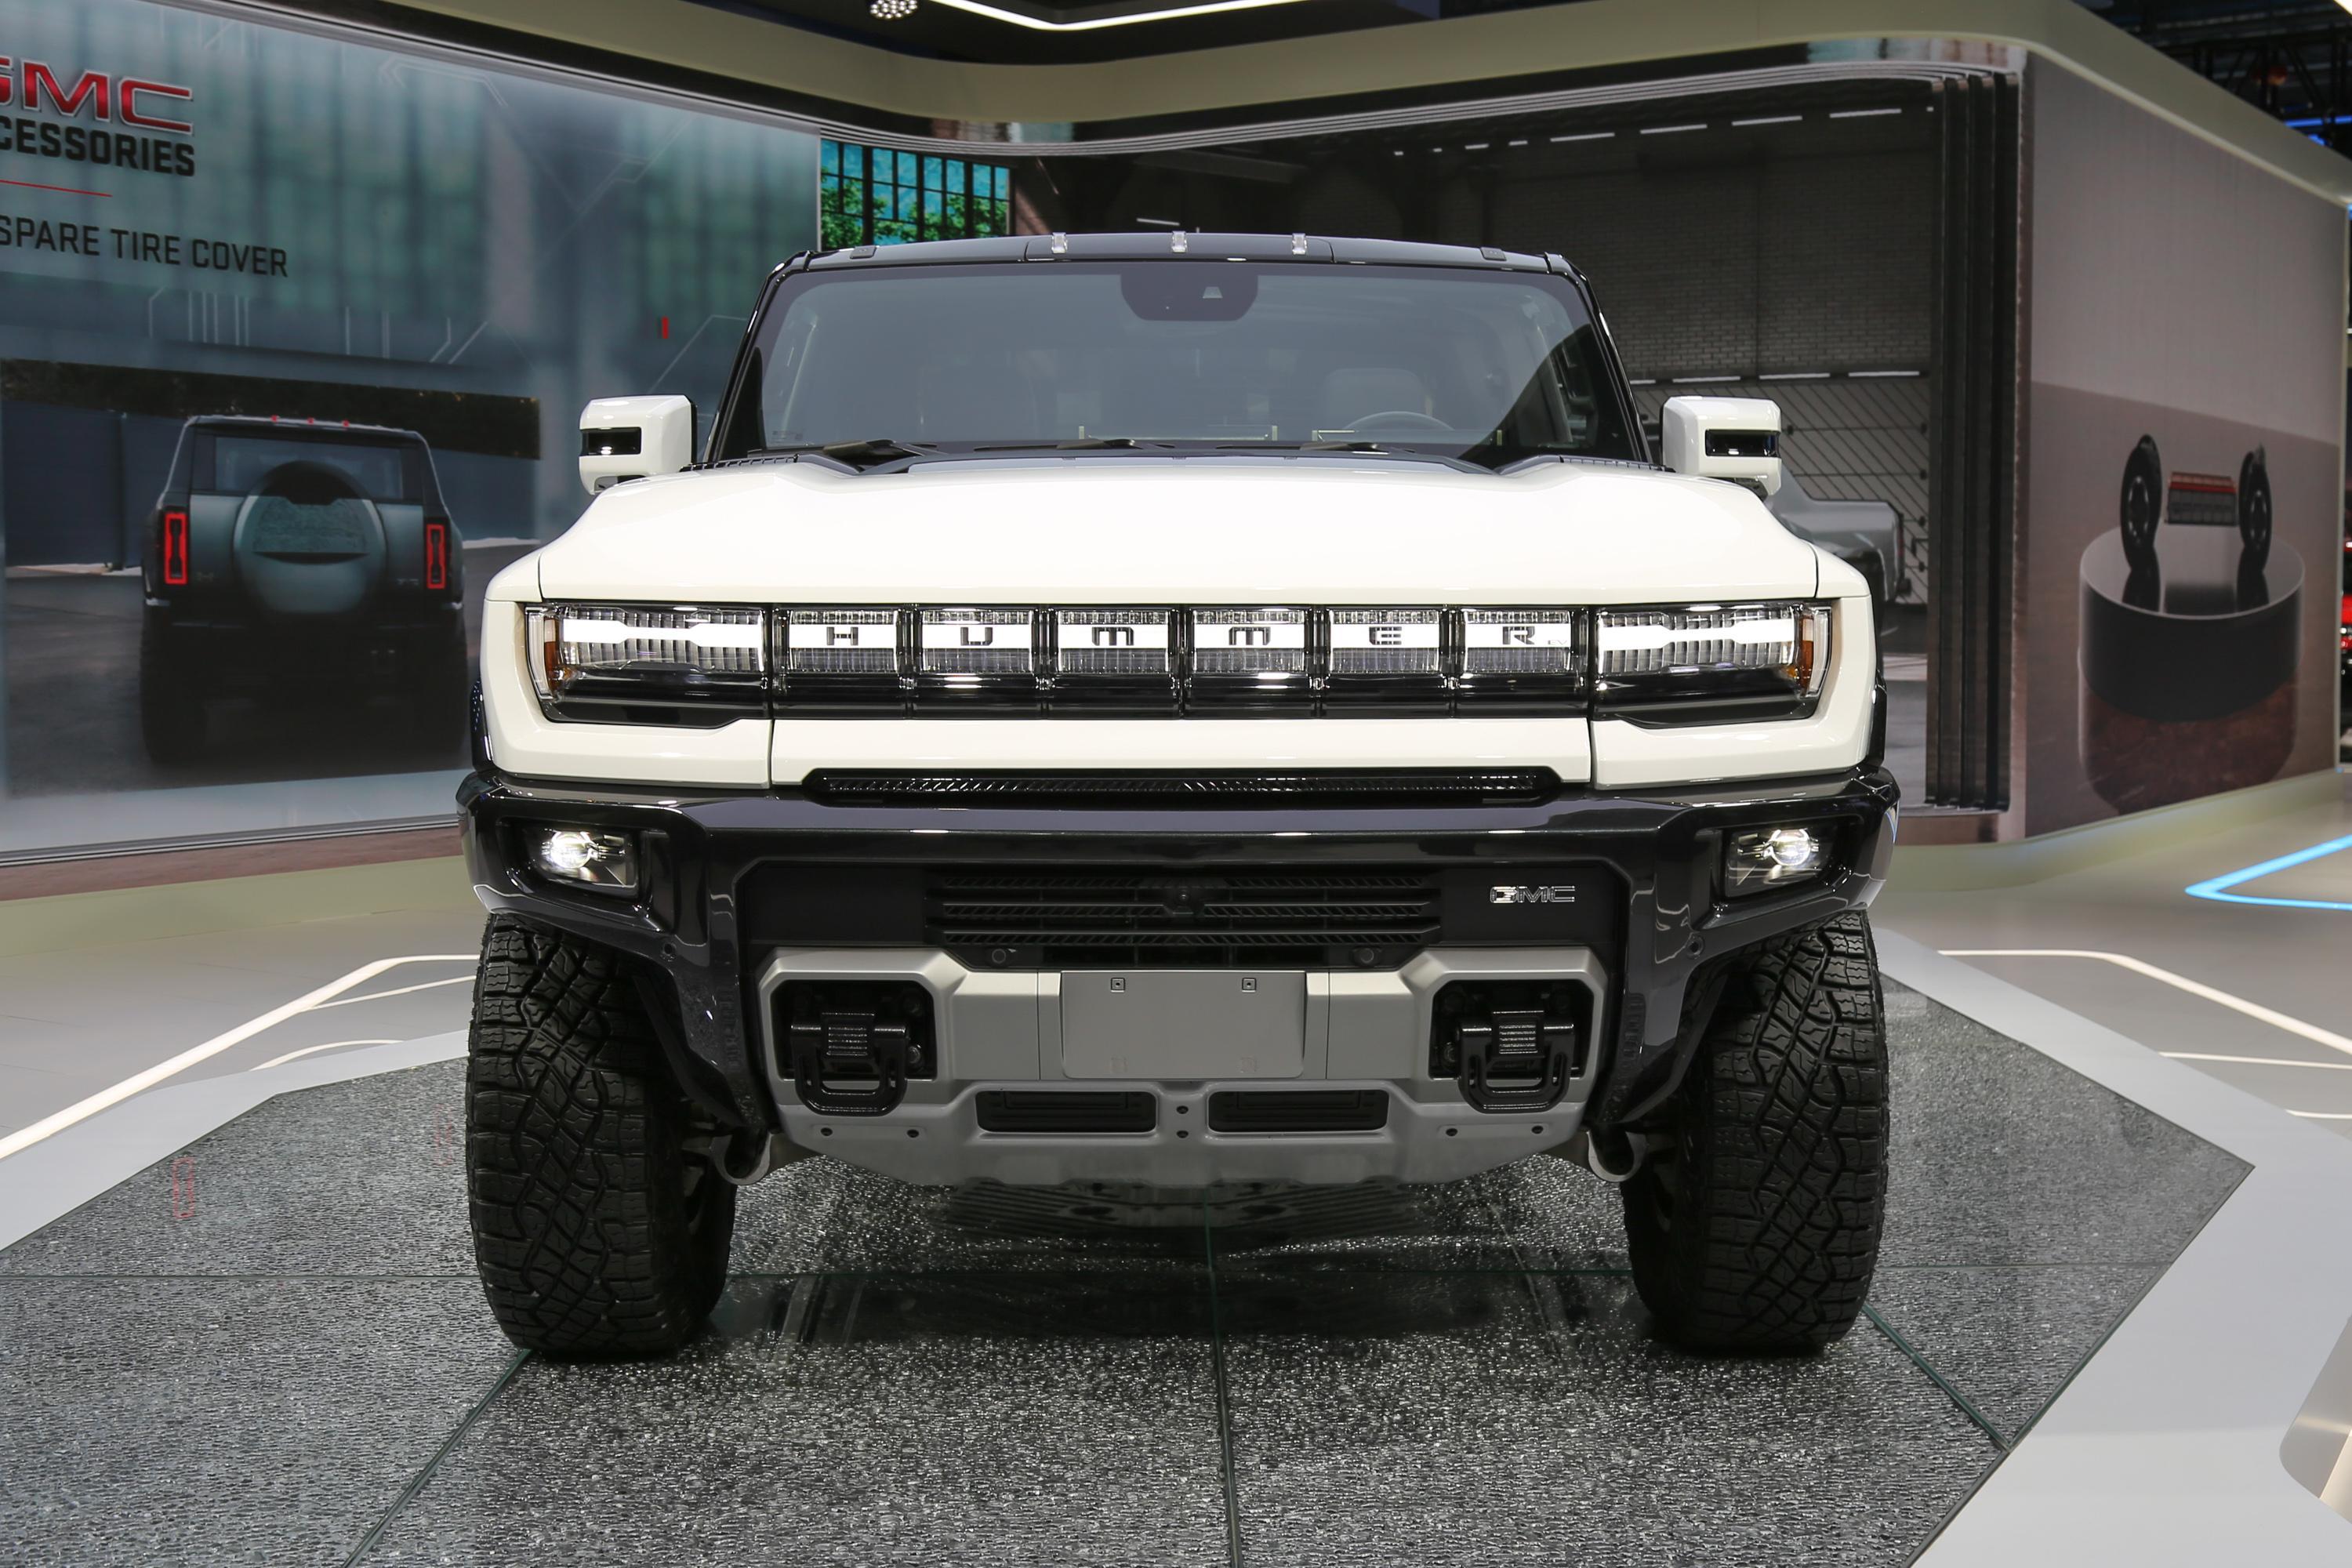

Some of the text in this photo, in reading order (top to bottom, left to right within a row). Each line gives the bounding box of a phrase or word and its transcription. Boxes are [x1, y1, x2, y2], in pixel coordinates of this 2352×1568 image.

[0, 56, 194, 135] MC
[0, 215, 288, 278] SPARE TIRE COVER
[826, 626, 1535, 646] HUMMER
[1490, 886, 1575, 903] GMC
